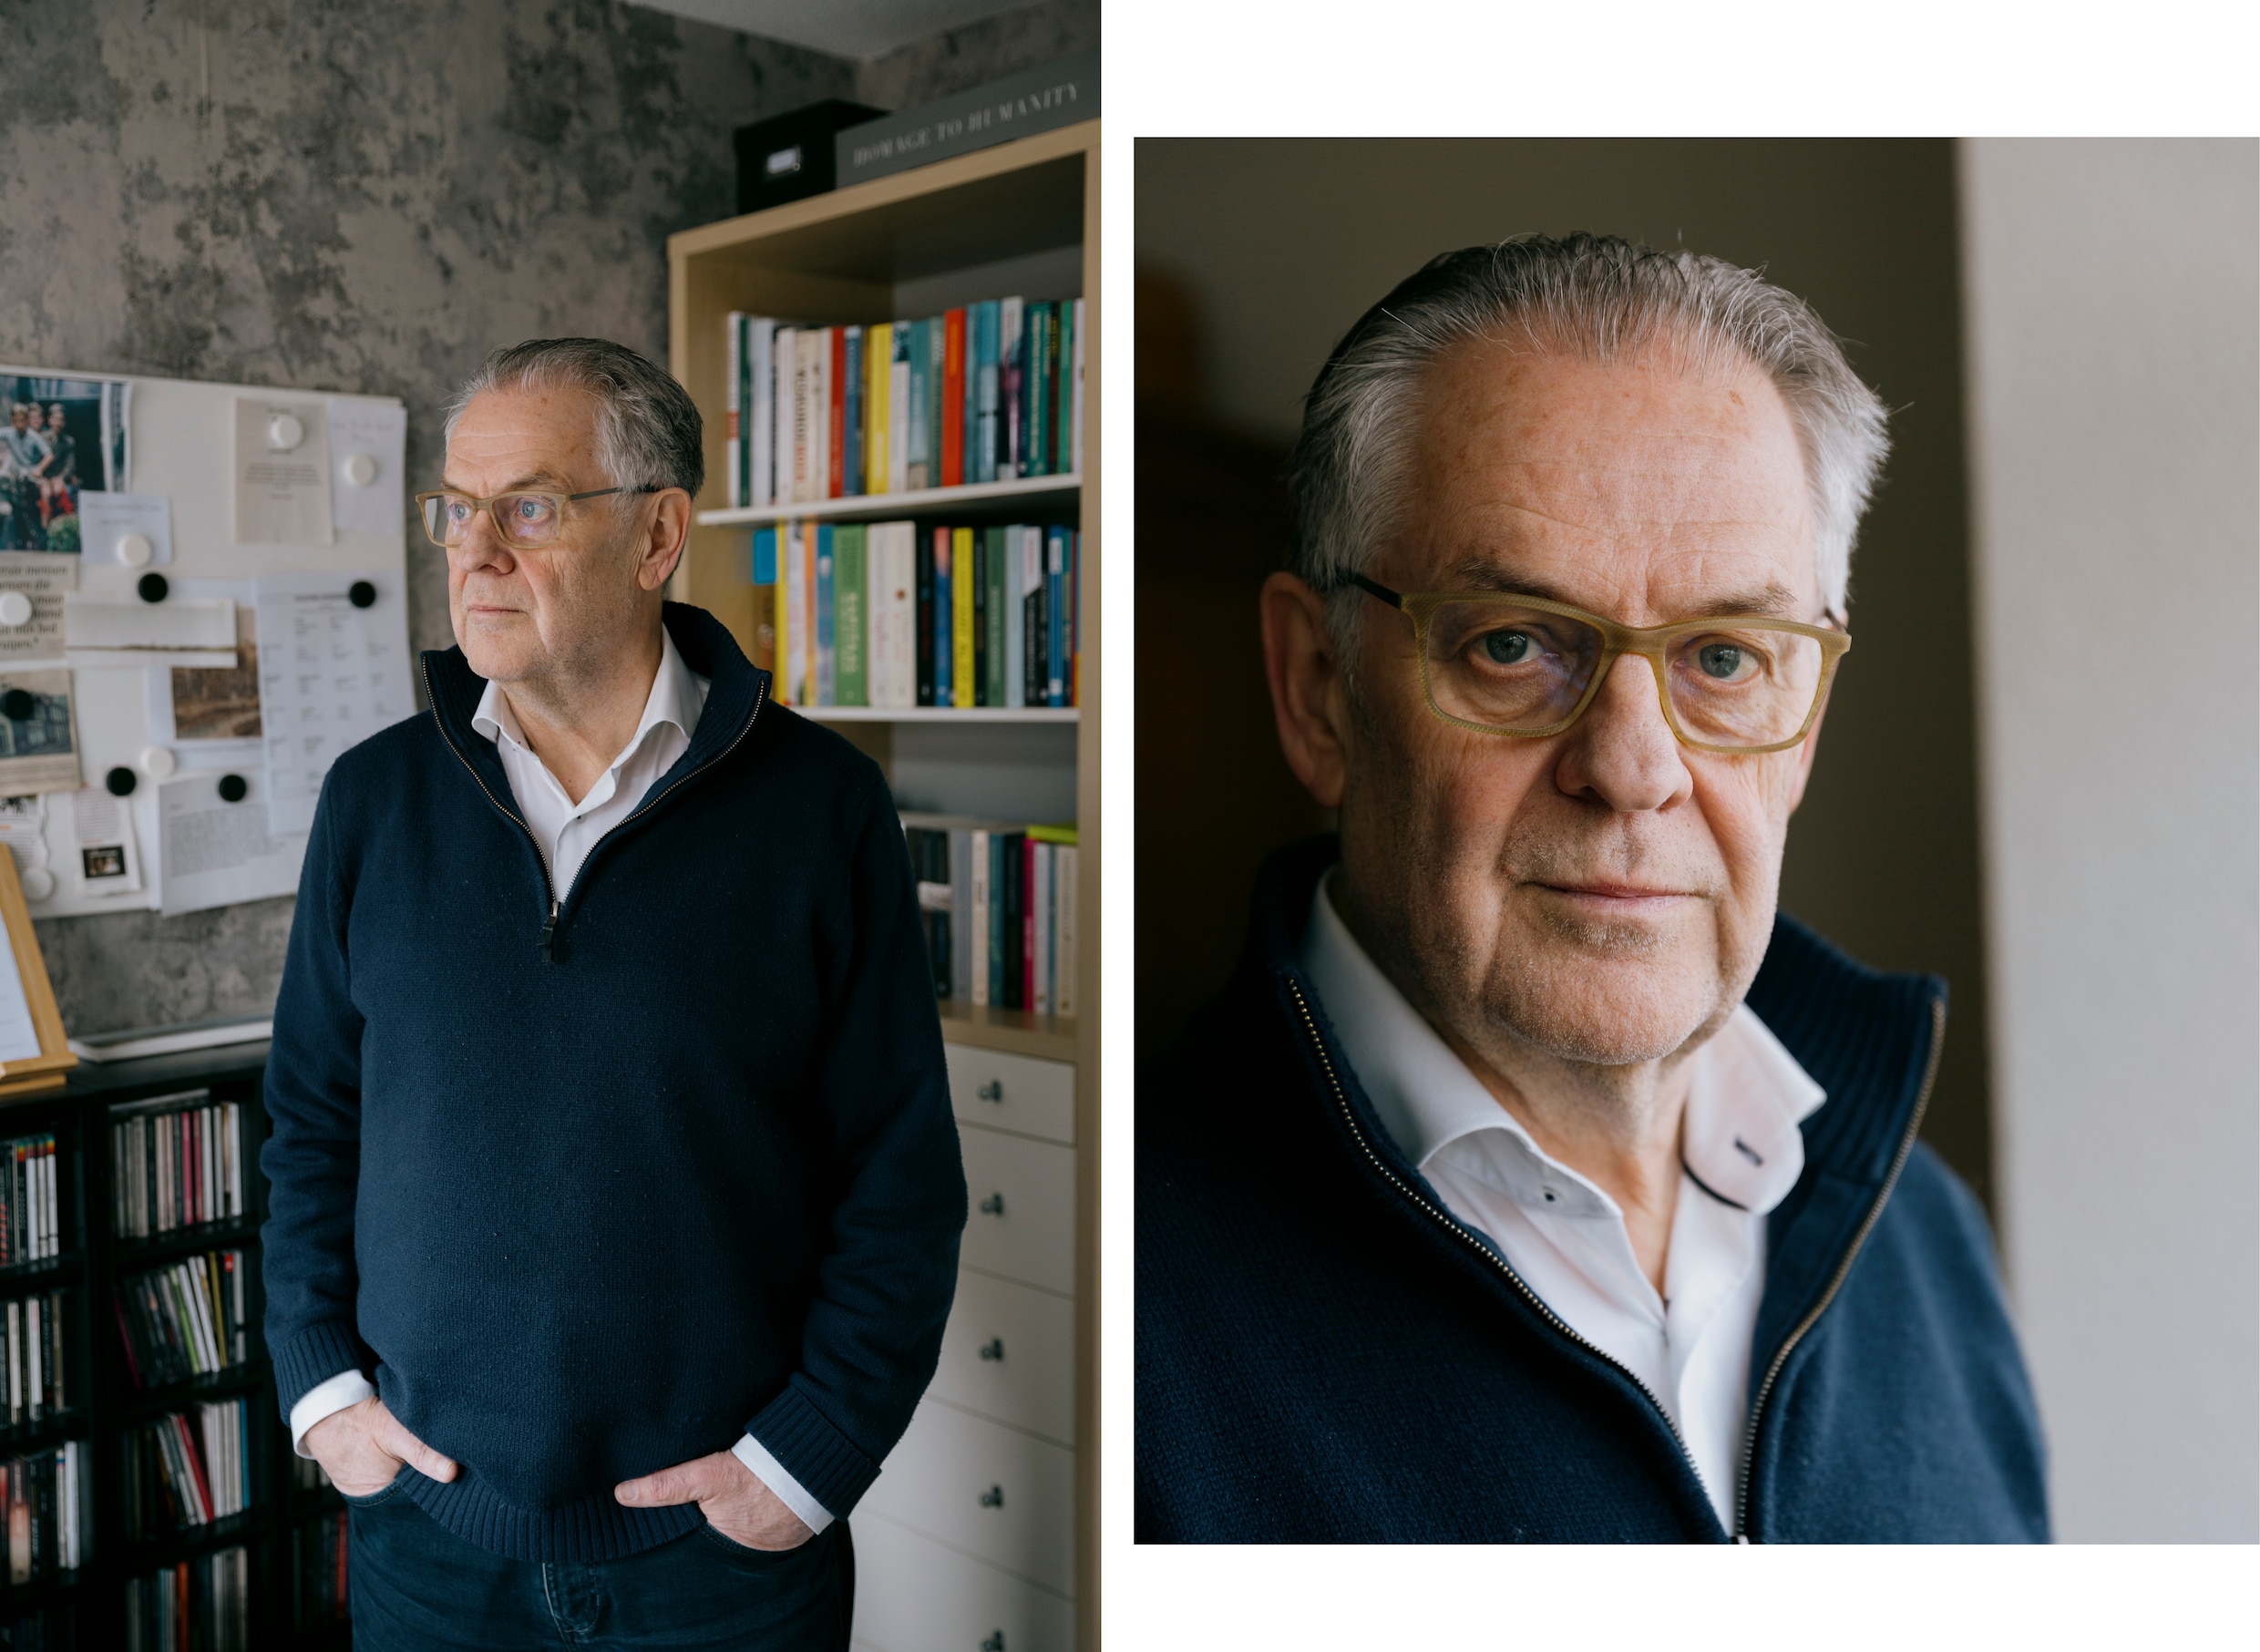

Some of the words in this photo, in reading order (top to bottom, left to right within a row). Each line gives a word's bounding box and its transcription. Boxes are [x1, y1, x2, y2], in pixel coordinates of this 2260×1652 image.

[853, 128, 930, 167] HOMAGE
[937, 118, 963, 141] TO
[968, 81, 1079, 132] HUMANITY
